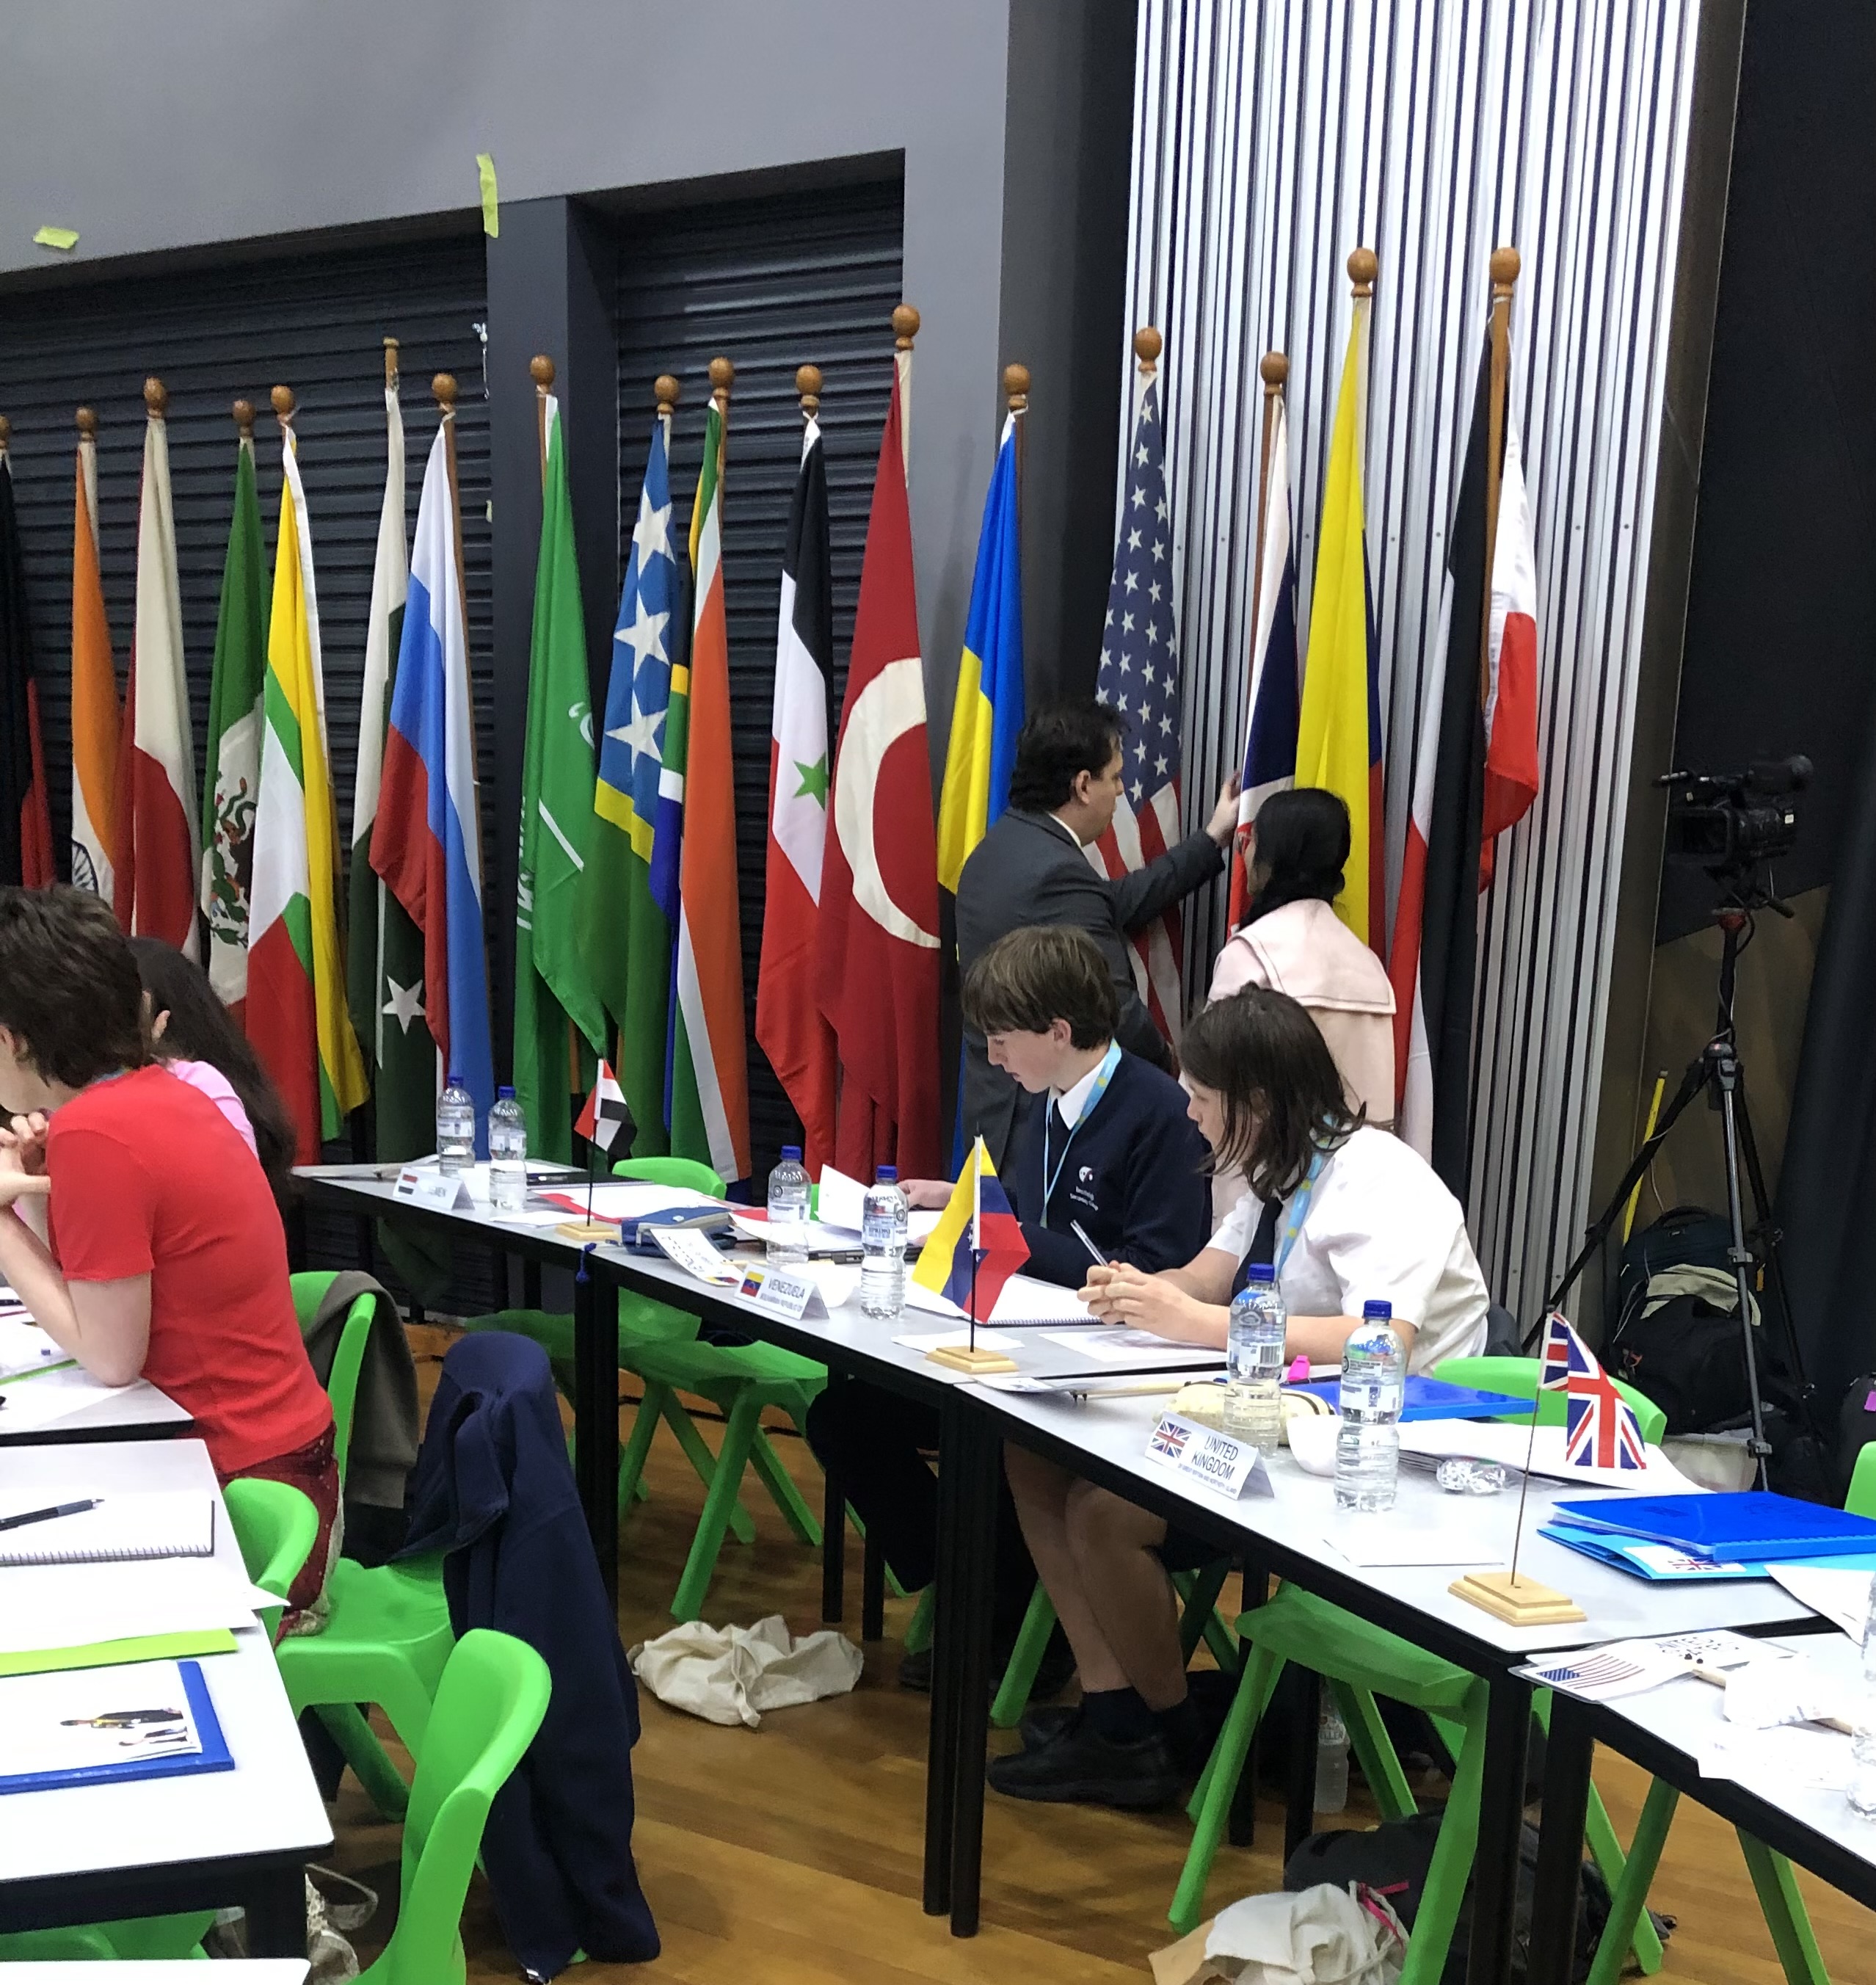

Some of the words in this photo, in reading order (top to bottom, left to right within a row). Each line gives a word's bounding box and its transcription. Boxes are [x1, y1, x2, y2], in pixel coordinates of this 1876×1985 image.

[768, 1277, 805, 1299] VENEZUELA
[1204, 1435, 1239, 1461] UNITED
[1190, 1451, 1235, 1480] KINGDOM
